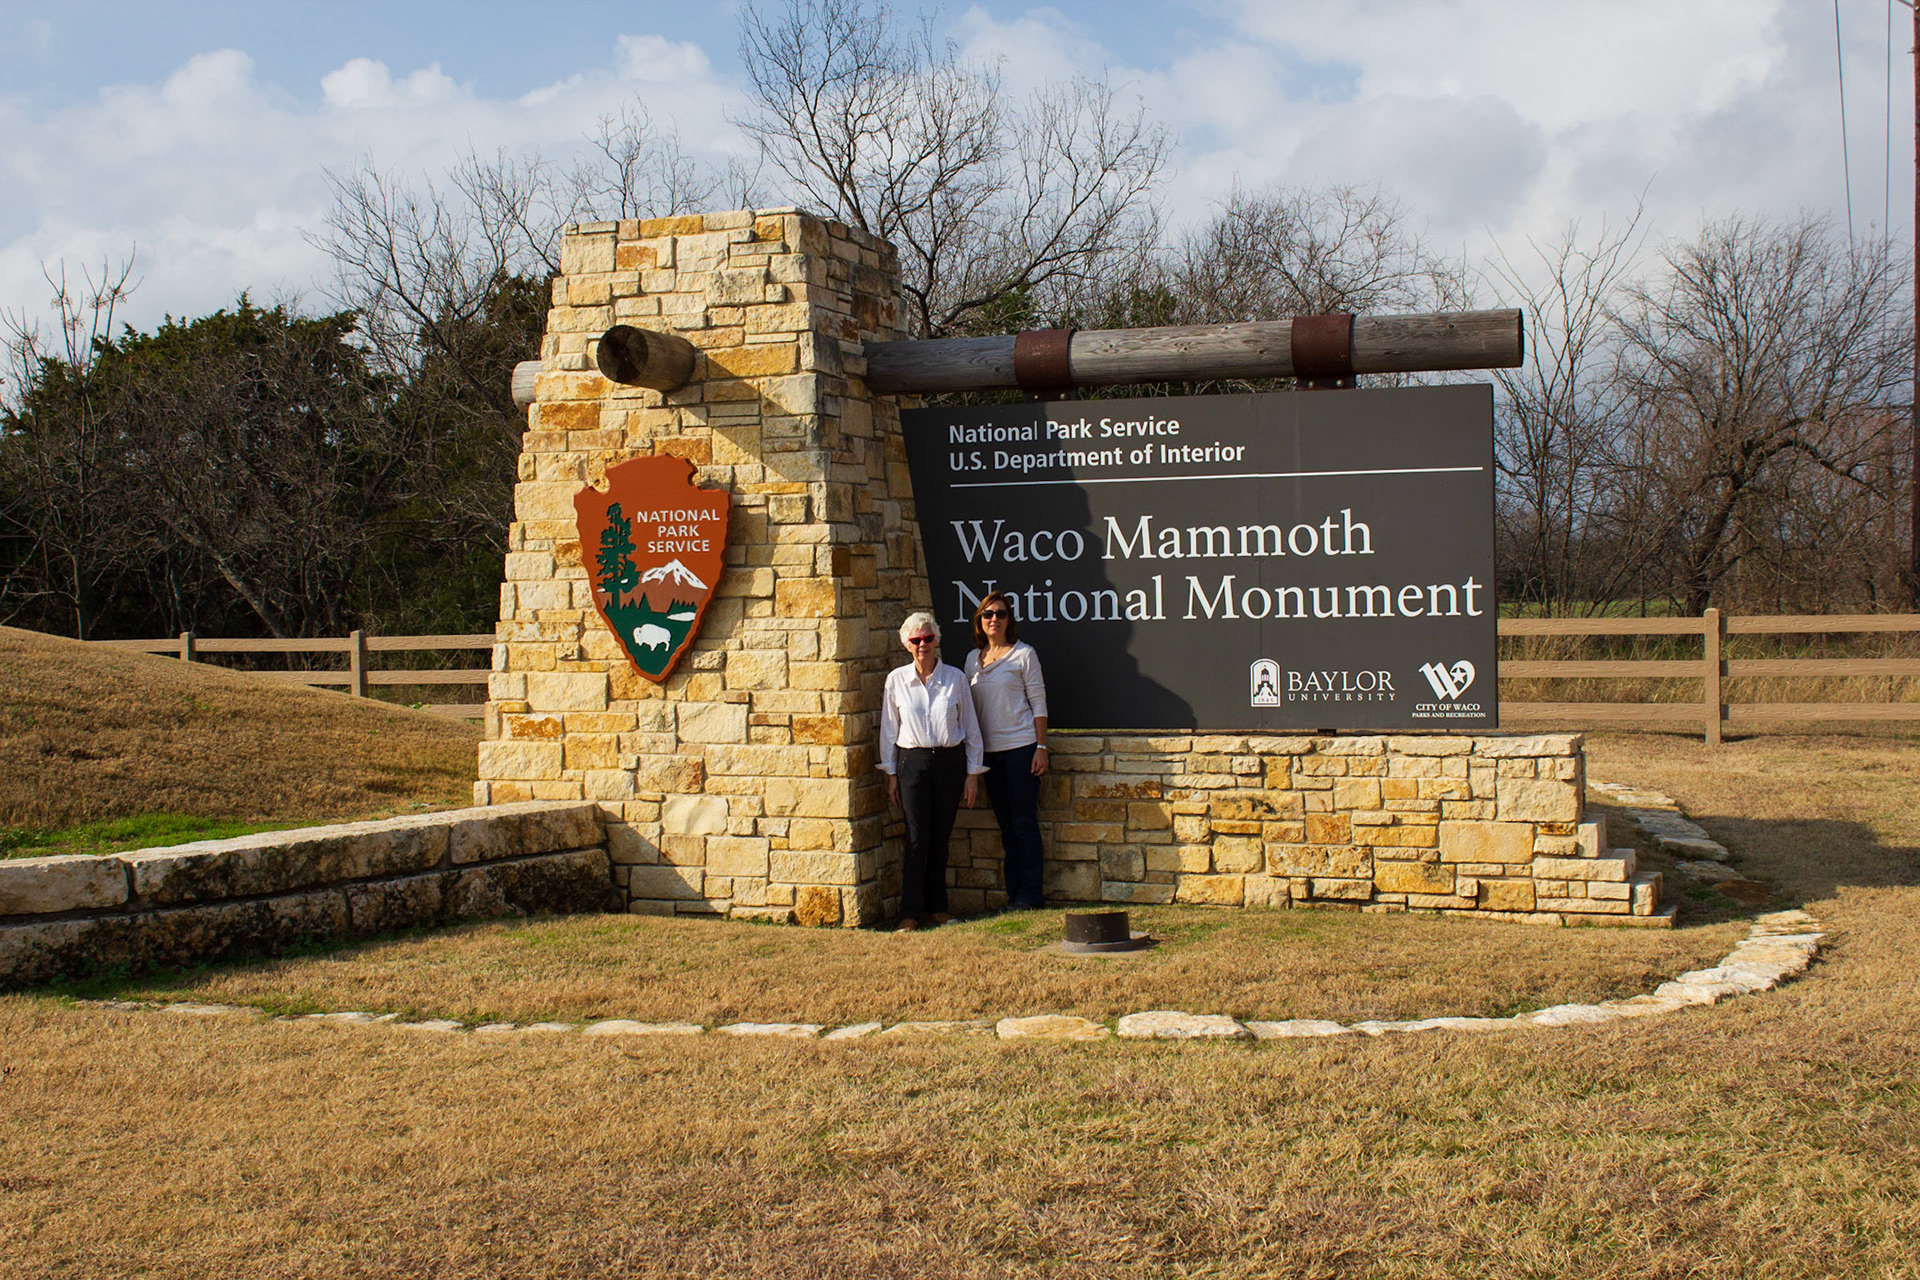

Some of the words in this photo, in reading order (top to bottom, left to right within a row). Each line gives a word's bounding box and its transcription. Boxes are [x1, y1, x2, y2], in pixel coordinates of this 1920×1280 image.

[949, 422, 1039, 444] National
[1045, 418, 1093, 439] Park
[1099, 415, 1180, 438] Service
[950, 451, 987, 471] U.S.
[994, 446, 1123, 473] Department
[1130, 443, 1153, 464] of
[1160, 441, 1245, 463] Interior
[637, 508, 720, 523] NATIONAL
[657, 524, 700, 538] PARK
[950, 519, 1085, 563] Waco
[1101, 508, 1375, 560] Mammoth
[647, 539, 711, 554] SERVICE
[1182, 575, 1483, 620] Monument
[1288, 670, 1395, 692] BAYLOR
[1288, 693, 1396, 702] UNIVERSITY
[1415, 703, 1437, 711] CITY
[1438, 703, 1452, 711] OF
[1453, 703, 1481, 711] WACO
